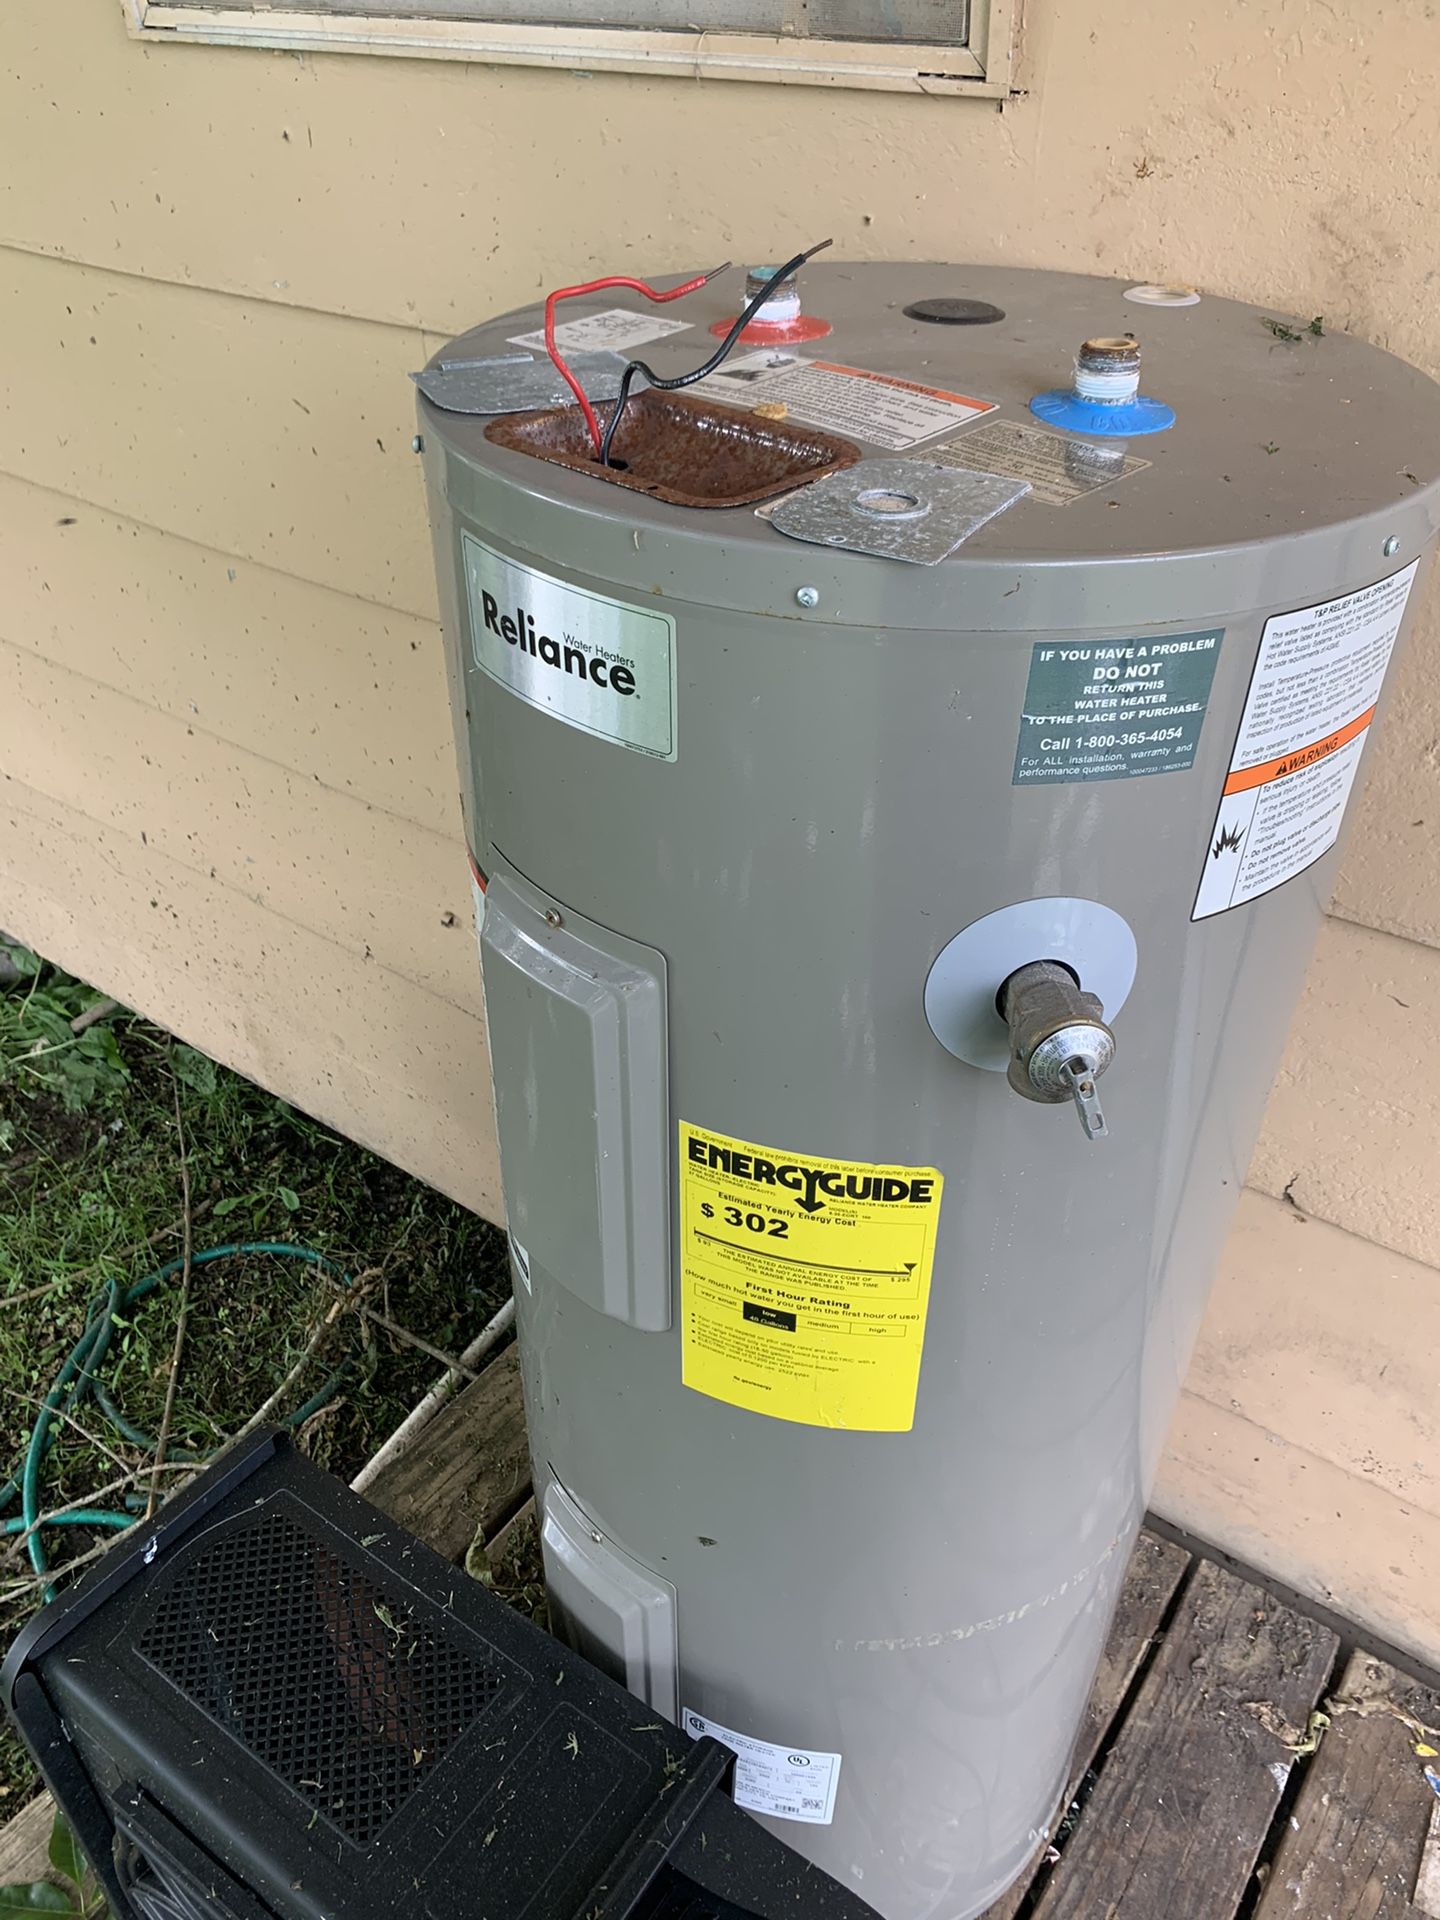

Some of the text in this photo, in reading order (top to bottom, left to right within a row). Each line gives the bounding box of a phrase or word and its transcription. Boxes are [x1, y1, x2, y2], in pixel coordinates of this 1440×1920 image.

[1314, 606, 1329, 619] T&P
[1329, 599, 1352, 613] RELIEF
[1353, 590, 1371, 605] VALVE
[481, 589, 636, 696] Reliance
[563, 632, 635, 668] Water Heaters
[1040, 638, 1215, 662] IF YOU HAVE A PROBLEM
[1093, 662, 1163, 680] DO NOT
[1083, 680, 1165, 695] RETURN THIS
[1074, 693, 1167, 709] WATER HEATER
[1029, 702, 1203, 725] TO THE PLACE OF PURCHASE.
[1040, 726, 1184, 751] Call 1-800-365-4054
[1021, 742, 1193, 766] For ALL installation, warranty and
[1289, 736, 1338, 771] WARNING
[1019, 765, 1080, 778] performance
[1082, 763, 1129, 775] questions.
[1272, 777, 1294, 790] reduce
[1251, 849, 1261, 858] Do
[1261, 843, 1272, 853] not
[1248, 861, 1257, 870] Do
[1258, 856, 1269, 864] not
[688, 1136, 934, 1207] ENERGYGUIDE
[744, 1145, 765, 1157] Federal
[775, 1154, 799, 1165] prohibits
[799, 1159, 822, 1168] removal
[829, 1163, 840, 1171] this
[841, 1165, 855, 1173] label
[856, 1166, 874, 1174] before
[700, 1202, 789, 1239] $ 302
[718, 1191, 762, 1210] Estimated
[765, 1204, 795, 1218] Yearly
[798, 1212, 832, 1226] Energy
[834, 1218, 857, 1228] Cost
[717, 1252, 732, 1261] THIS
[732, 1256, 757, 1269] MODEL
[758, 1263, 775, 1273] WAS
[775, 1268, 791, 1277] NOT
[792, 1271, 833, 1284] AVAILABLE
[723, 1248, 736, 1257] THE
[737, 1251, 777, 1267] ESTIMATED
[778, 1263, 807, 1275] ANNUAL
[808, 1268, 839, 1279] ENERGY
[840, 1273, 860, 1281] COST
[745, 1266, 760, 1274] THE
[760, 1269, 785, 1280] RANGE
[785, 1276, 803, 1285] WAS
[685, 1268, 706, 1282] (How
[708, 1276, 732, 1291] much
[733, 1284, 748, 1296] hot
[749, 1291, 775, 1303] water
[776, 1297, 795, 1309] you
[796, 1302, 811, 1312] get
[824, 1308, 840, 1316] the
[841, 1310, 862, 1318] first
[863, 1311, 885, 1319] hour
[701, 1290, 737, 1306] very small
[745, 1280, 851, 1310] First Hour Rating
[807, 1320, 840, 1330] medium
